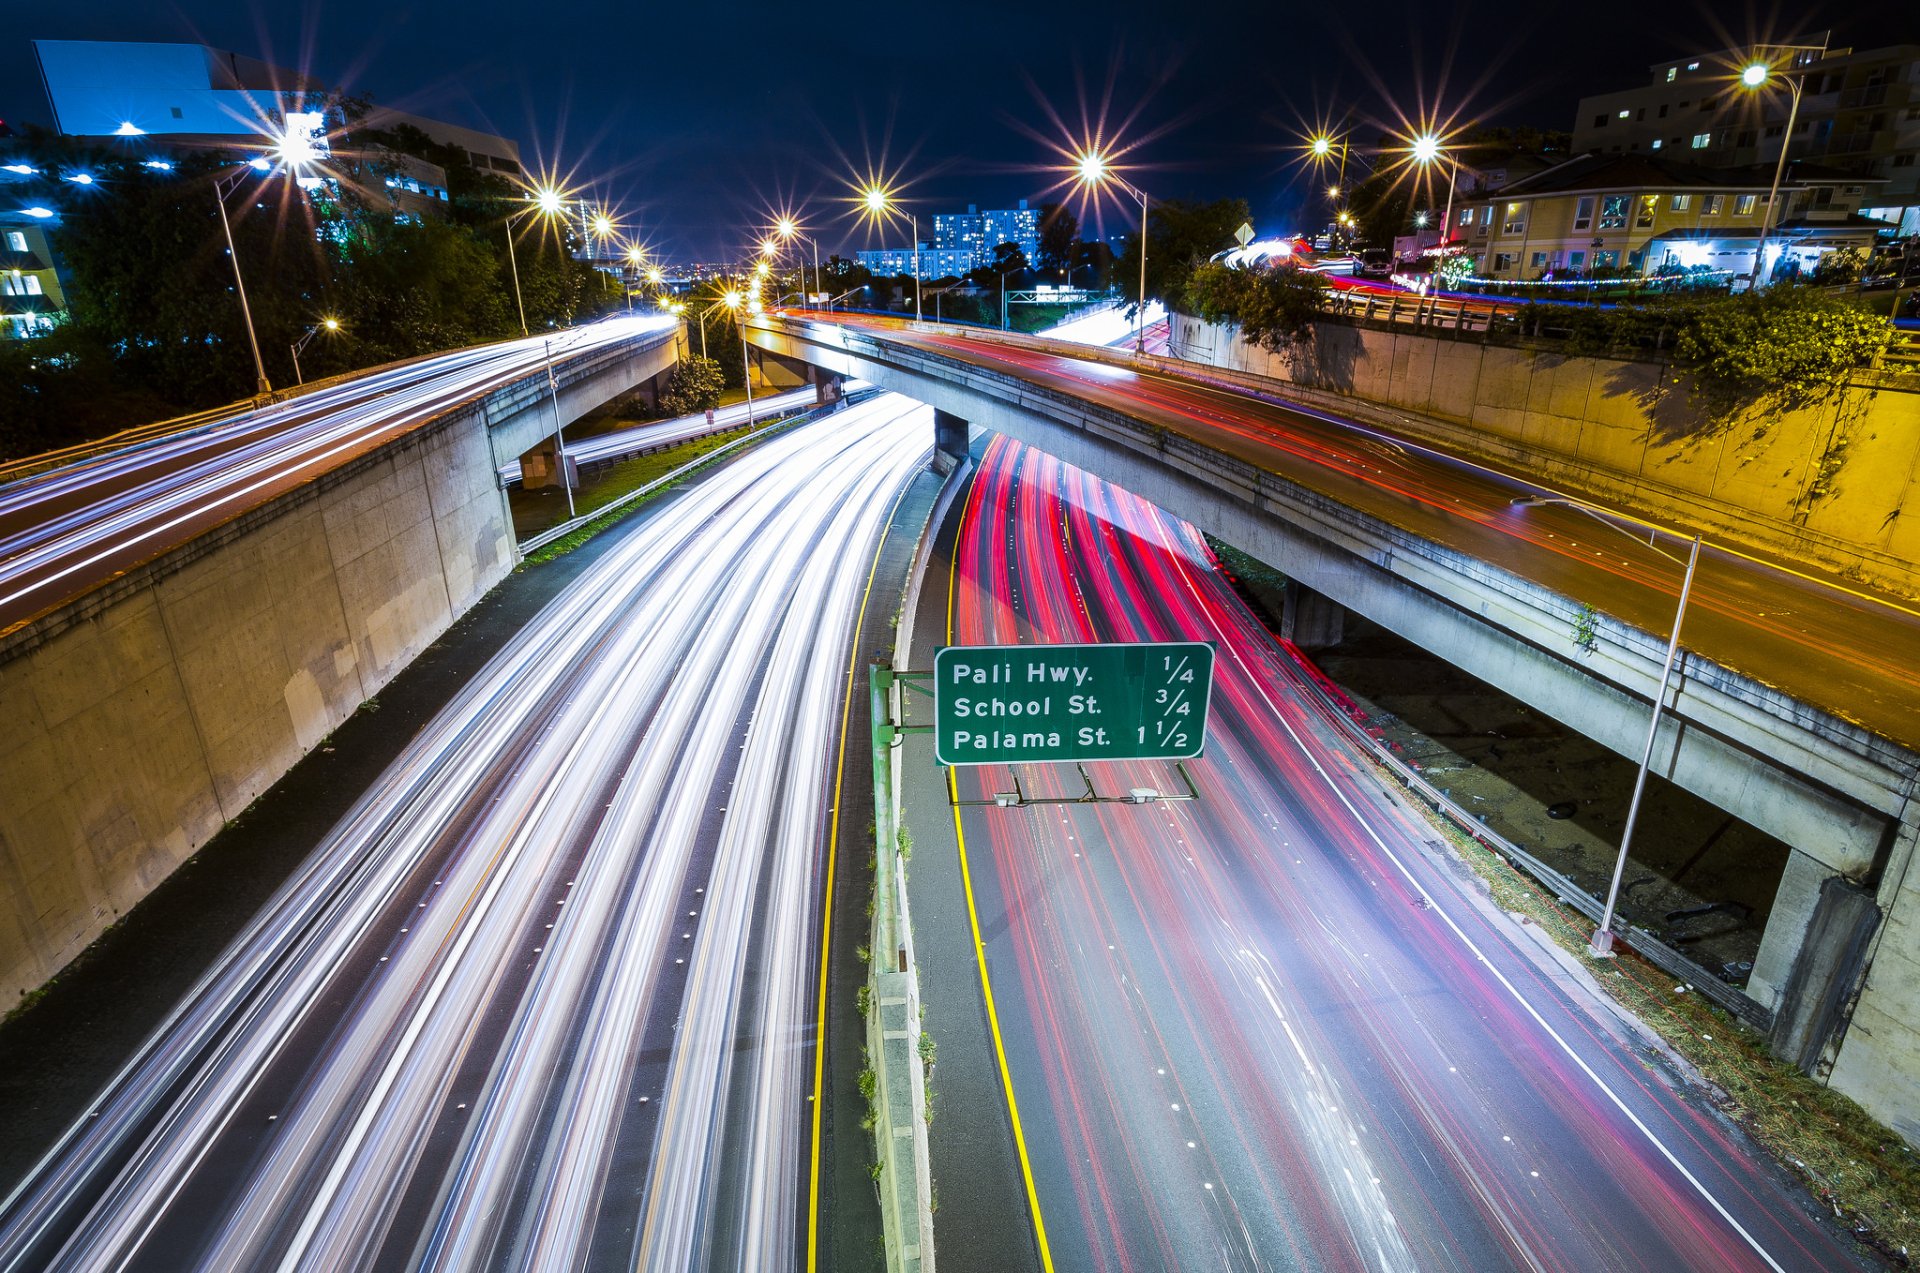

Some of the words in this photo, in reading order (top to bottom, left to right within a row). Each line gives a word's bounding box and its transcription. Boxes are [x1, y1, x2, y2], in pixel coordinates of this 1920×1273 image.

[953, 663, 1011, 684] Pali
[1027, 662, 1093, 687] Hwy.
[1163, 655, 1194, 684] 1/4
[953, 696, 1050, 717] School
[1068, 695, 1102, 715] St.
[1155, 688, 1191, 716] 3/4
[953, 730, 1060, 749] Palama
[1078, 726, 1111, 746] St.
